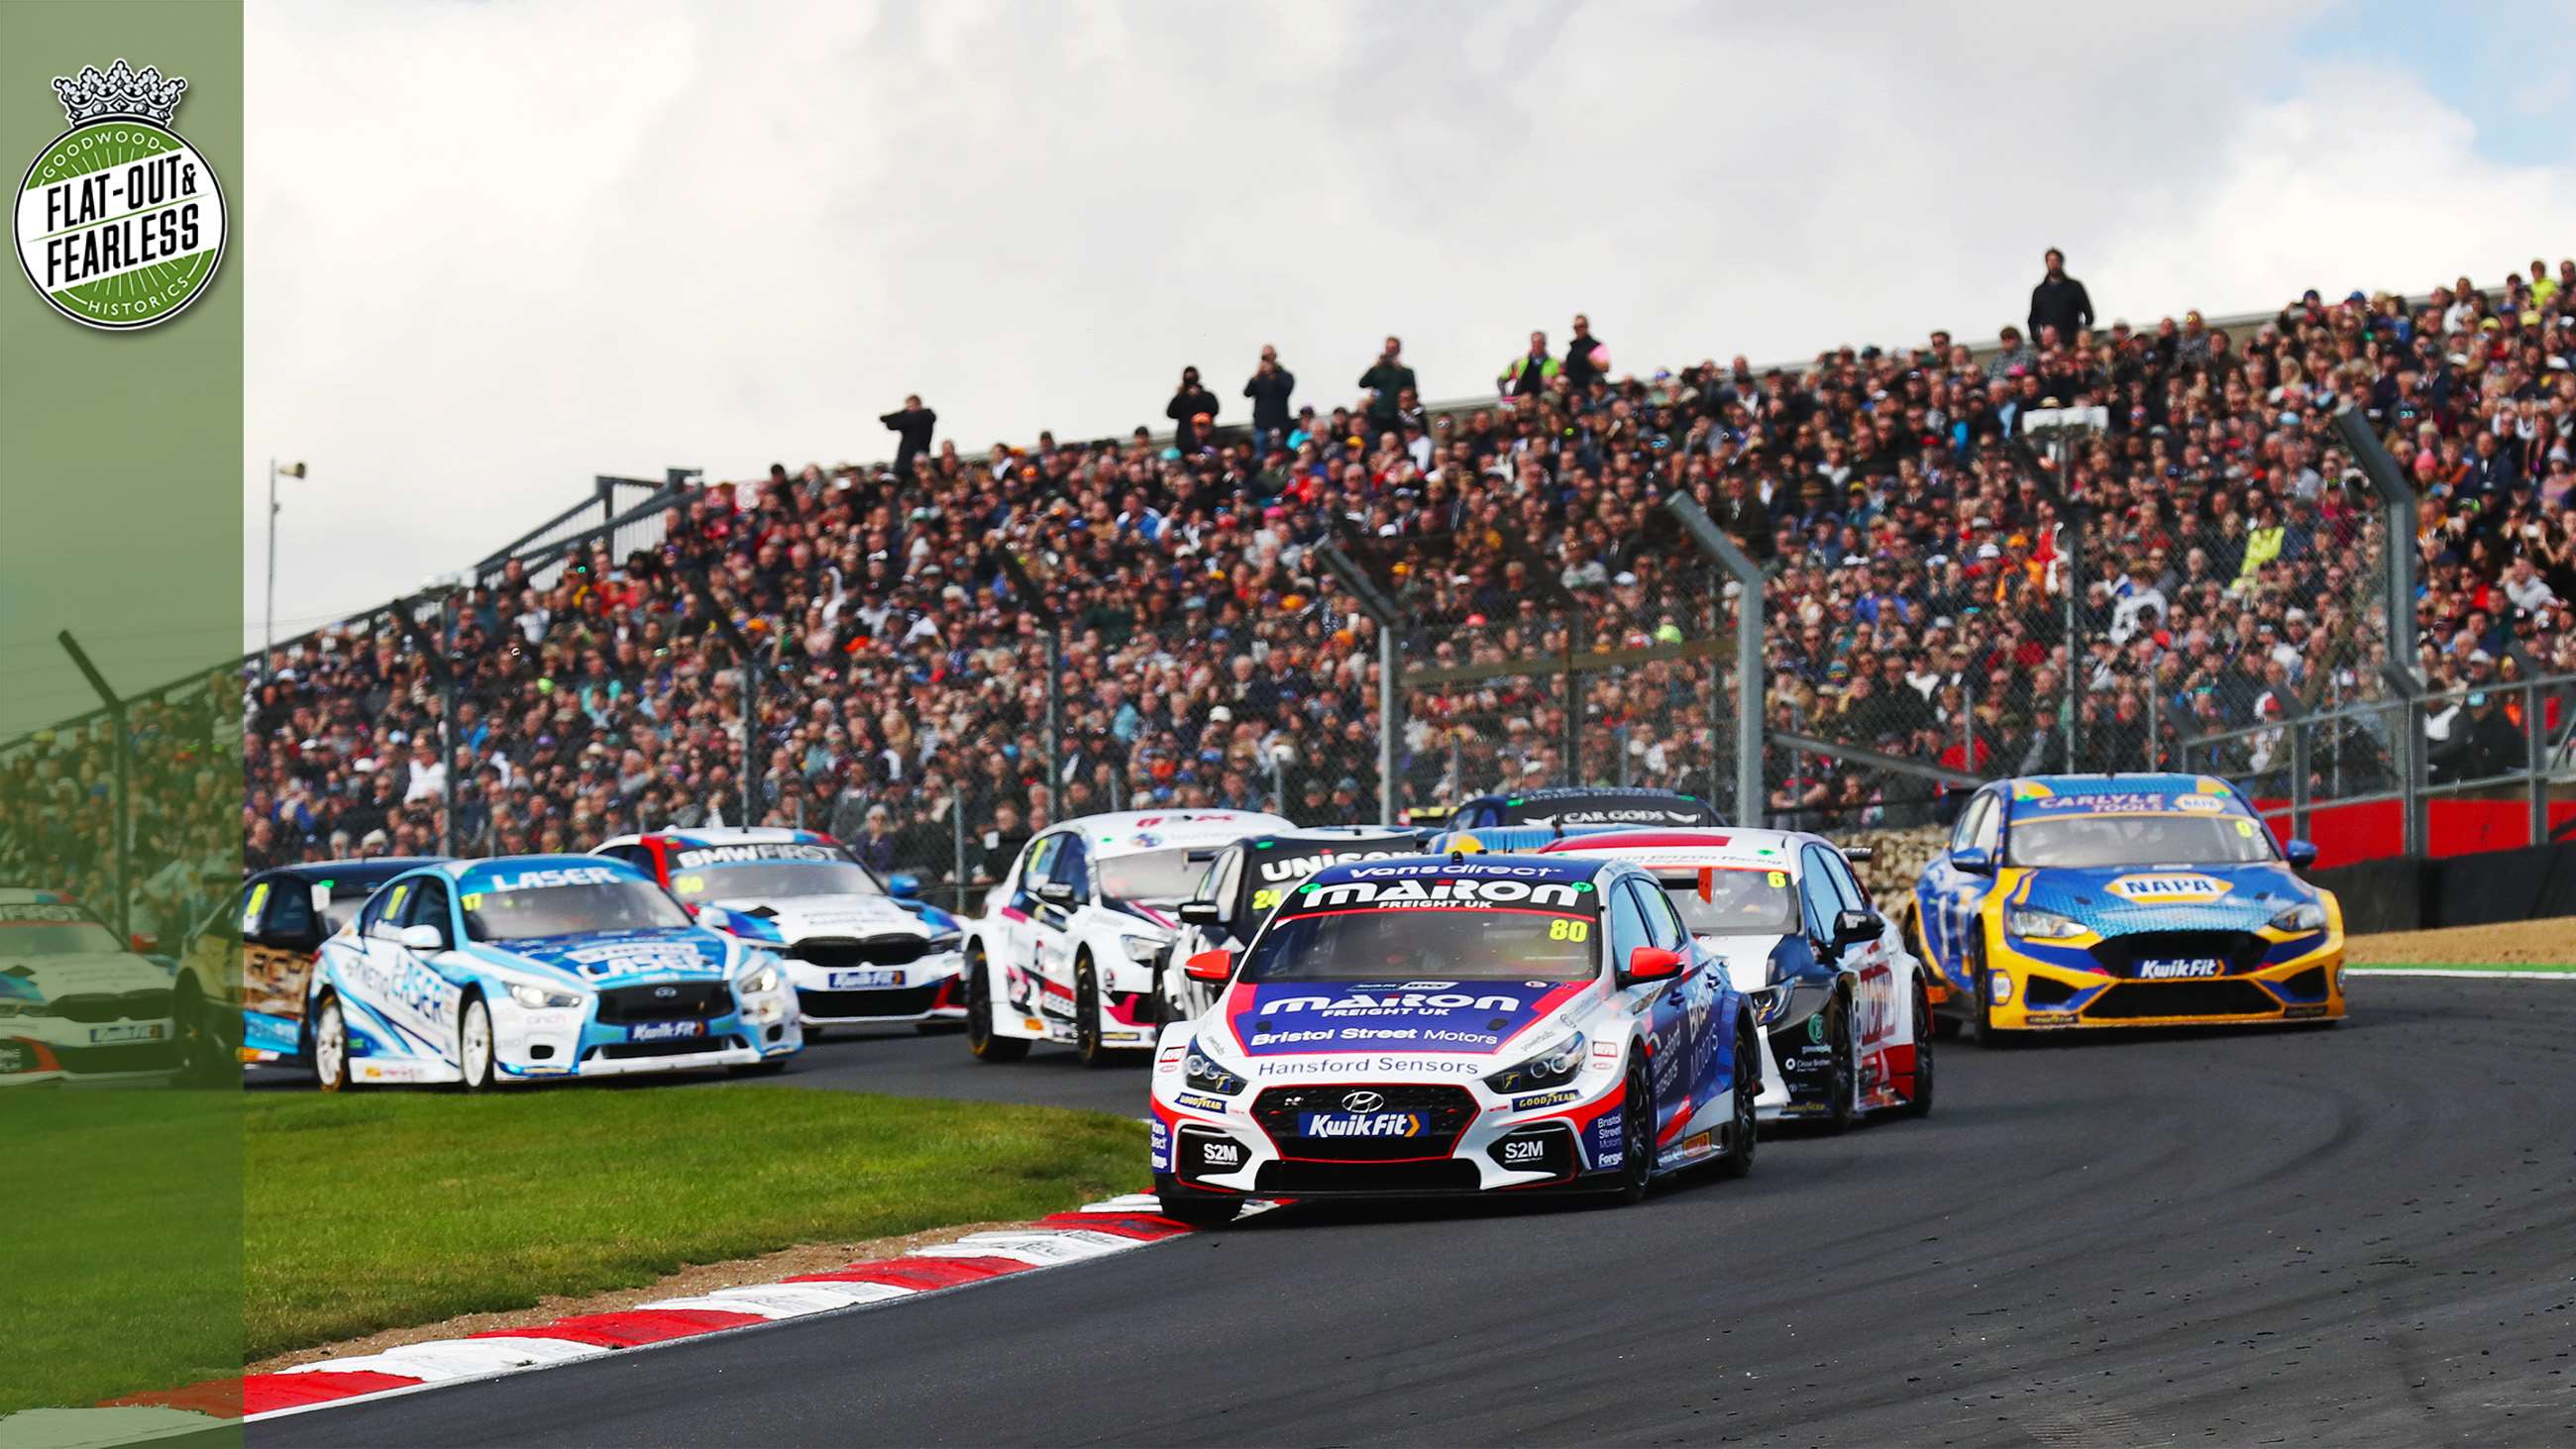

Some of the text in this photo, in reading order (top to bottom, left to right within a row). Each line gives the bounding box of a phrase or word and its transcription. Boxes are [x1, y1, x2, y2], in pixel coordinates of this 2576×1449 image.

[2038, 793, 2164, 809] CARLYLE
[2093, 803, 2162, 813] TOOLS
[1563, 809, 1666, 824] CAR GODS
[491, 867, 622, 892] LASER
[2125, 880, 2213, 893] NAPA
[1252, 889, 1283, 909] 24
[1378, 899, 1493, 909] FREIGHT UK
[1550, 919, 1588, 942] 80
[1321, 1007, 1414, 1018] FREIGHT
[1250, 1027, 1498, 1047] Bristol Street Motors
[1258, 1057, 1480, 1077] Hansford Sensors
[1519, 1092, 1576, 1108] GOODYEAR
[1597, 1114, 1622, 1128] Bristol
[1204, 1142, 1238, 1162] S2M
[1505, 1140, 1544, 1159] S2M
